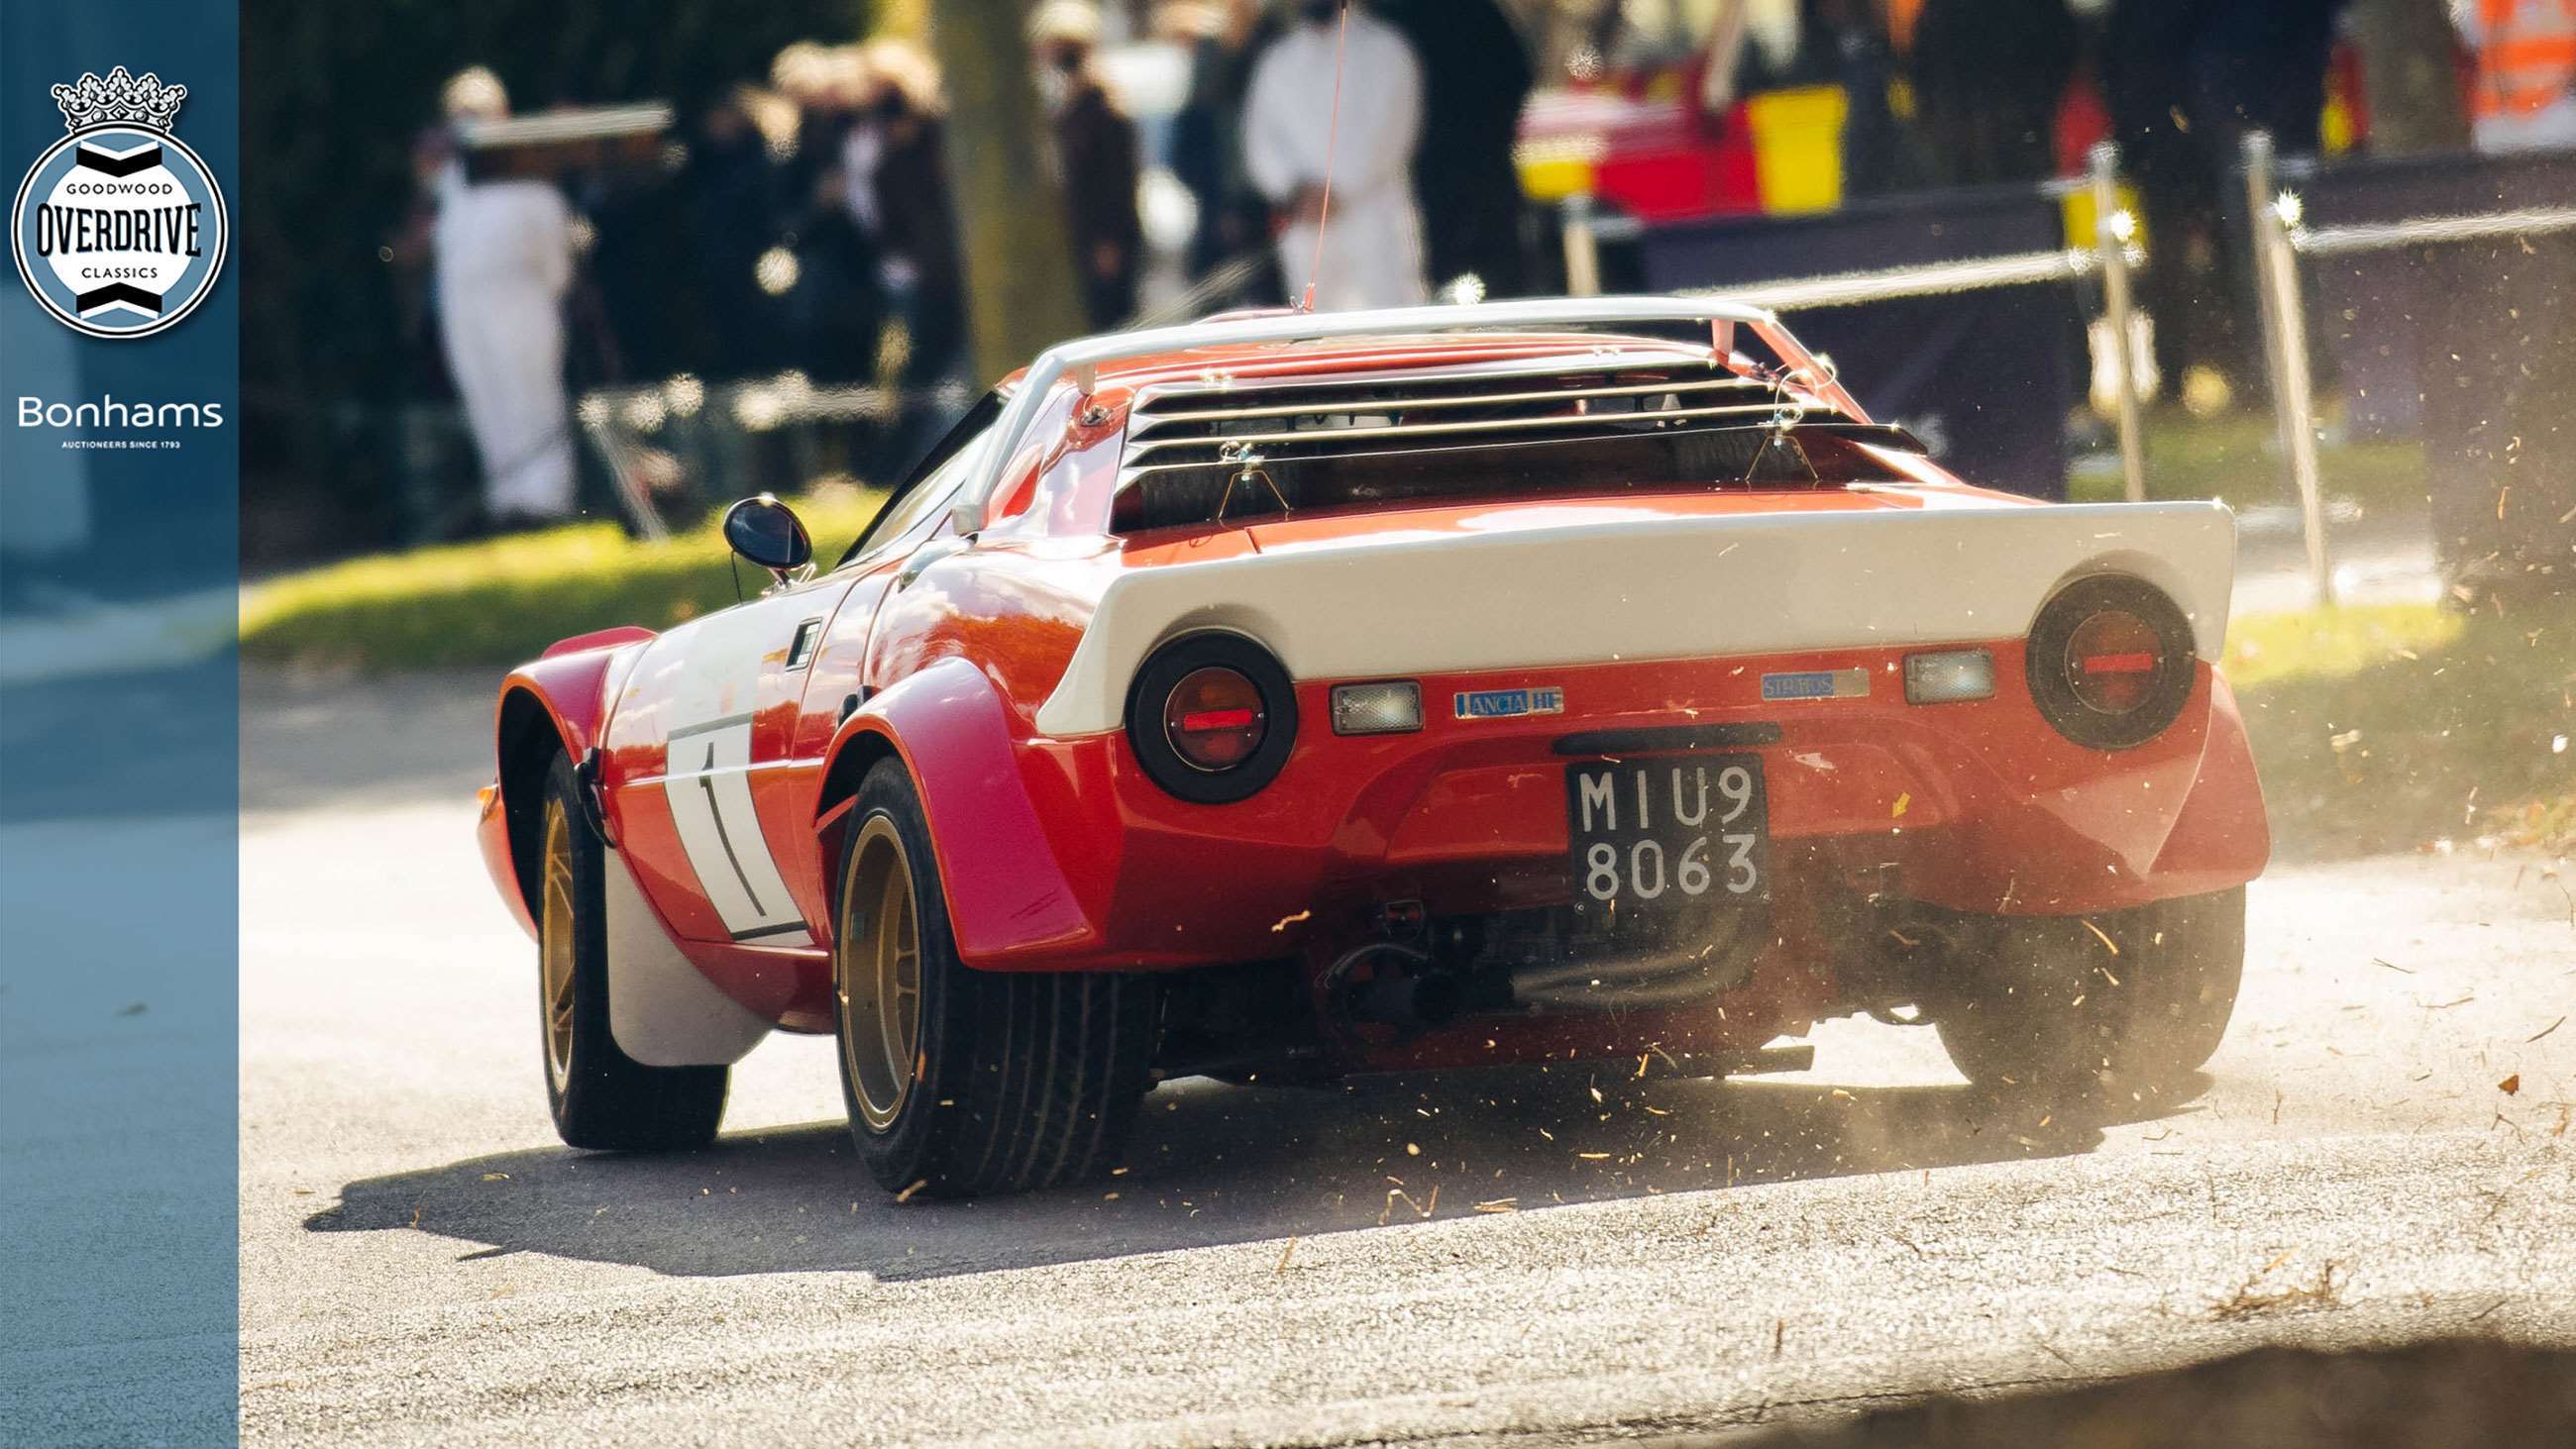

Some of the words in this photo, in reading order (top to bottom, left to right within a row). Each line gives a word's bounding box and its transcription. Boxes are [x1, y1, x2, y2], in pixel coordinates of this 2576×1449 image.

[1463, 692, 1530, 717] LANCIA
[1764, 676, 1833, 696] STROS
[698, 742, 767, 917] 1
[1587, 834, 1758, 900] 8063
